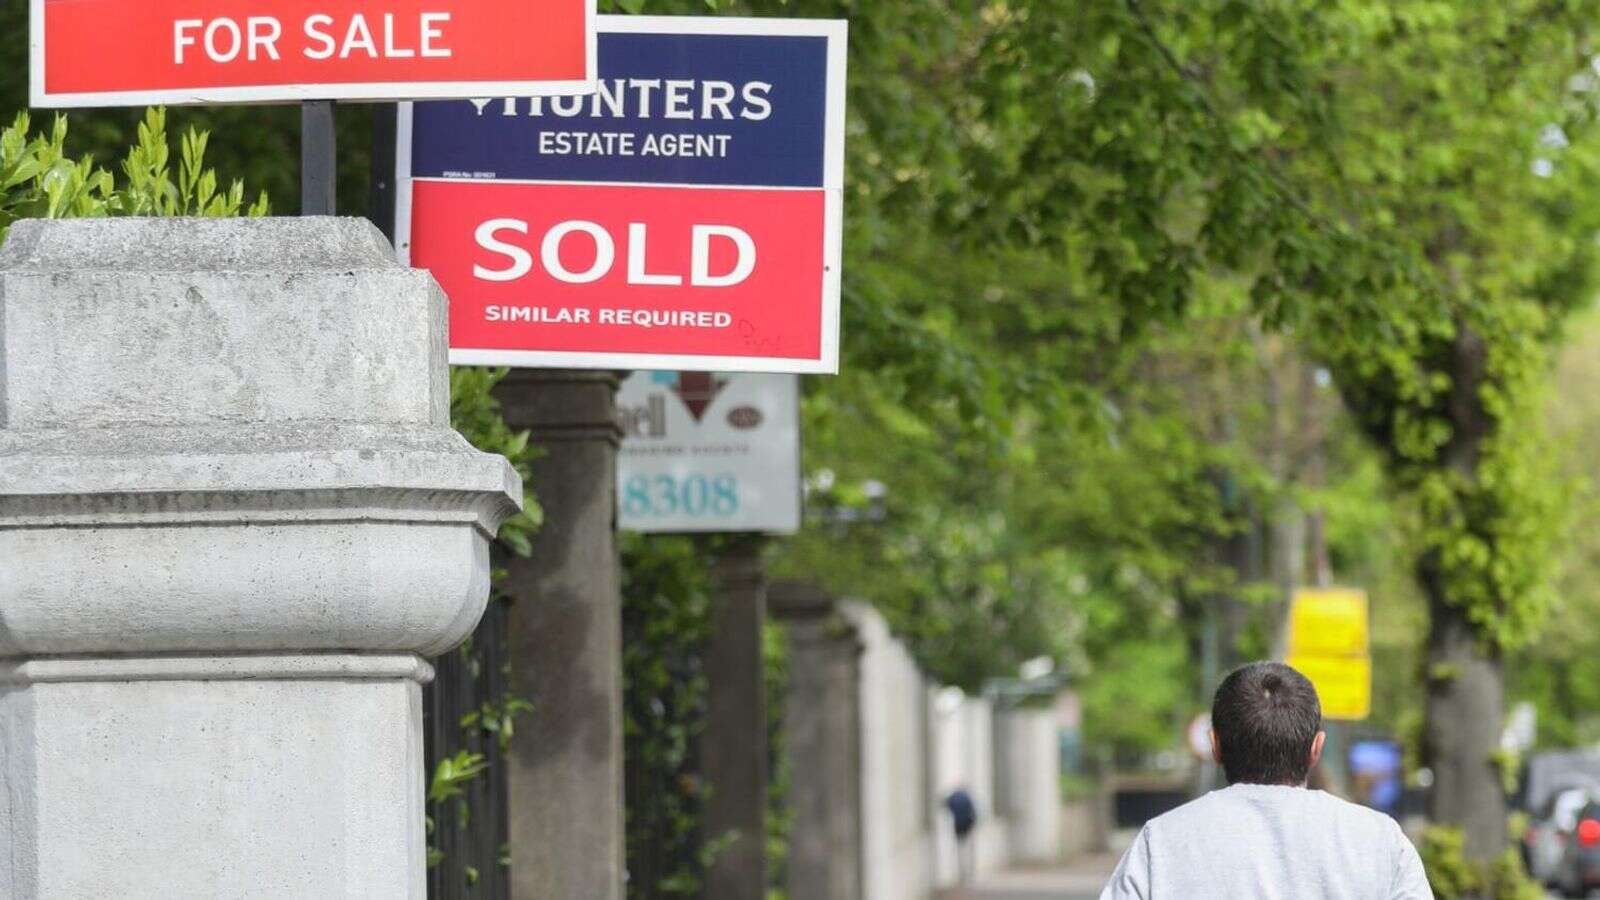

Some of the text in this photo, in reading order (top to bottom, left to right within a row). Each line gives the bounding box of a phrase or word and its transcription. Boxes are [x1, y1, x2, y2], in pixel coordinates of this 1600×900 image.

[174, 12, 452, 64] FOR SALE
[538, 131, 732, 157] ESTATE AGENT
[473, 218, 757, 287] SOLD
[485, 305, 732, 327] SIMILAR REQUIRED
[624, 473, 740, 518] 8308
